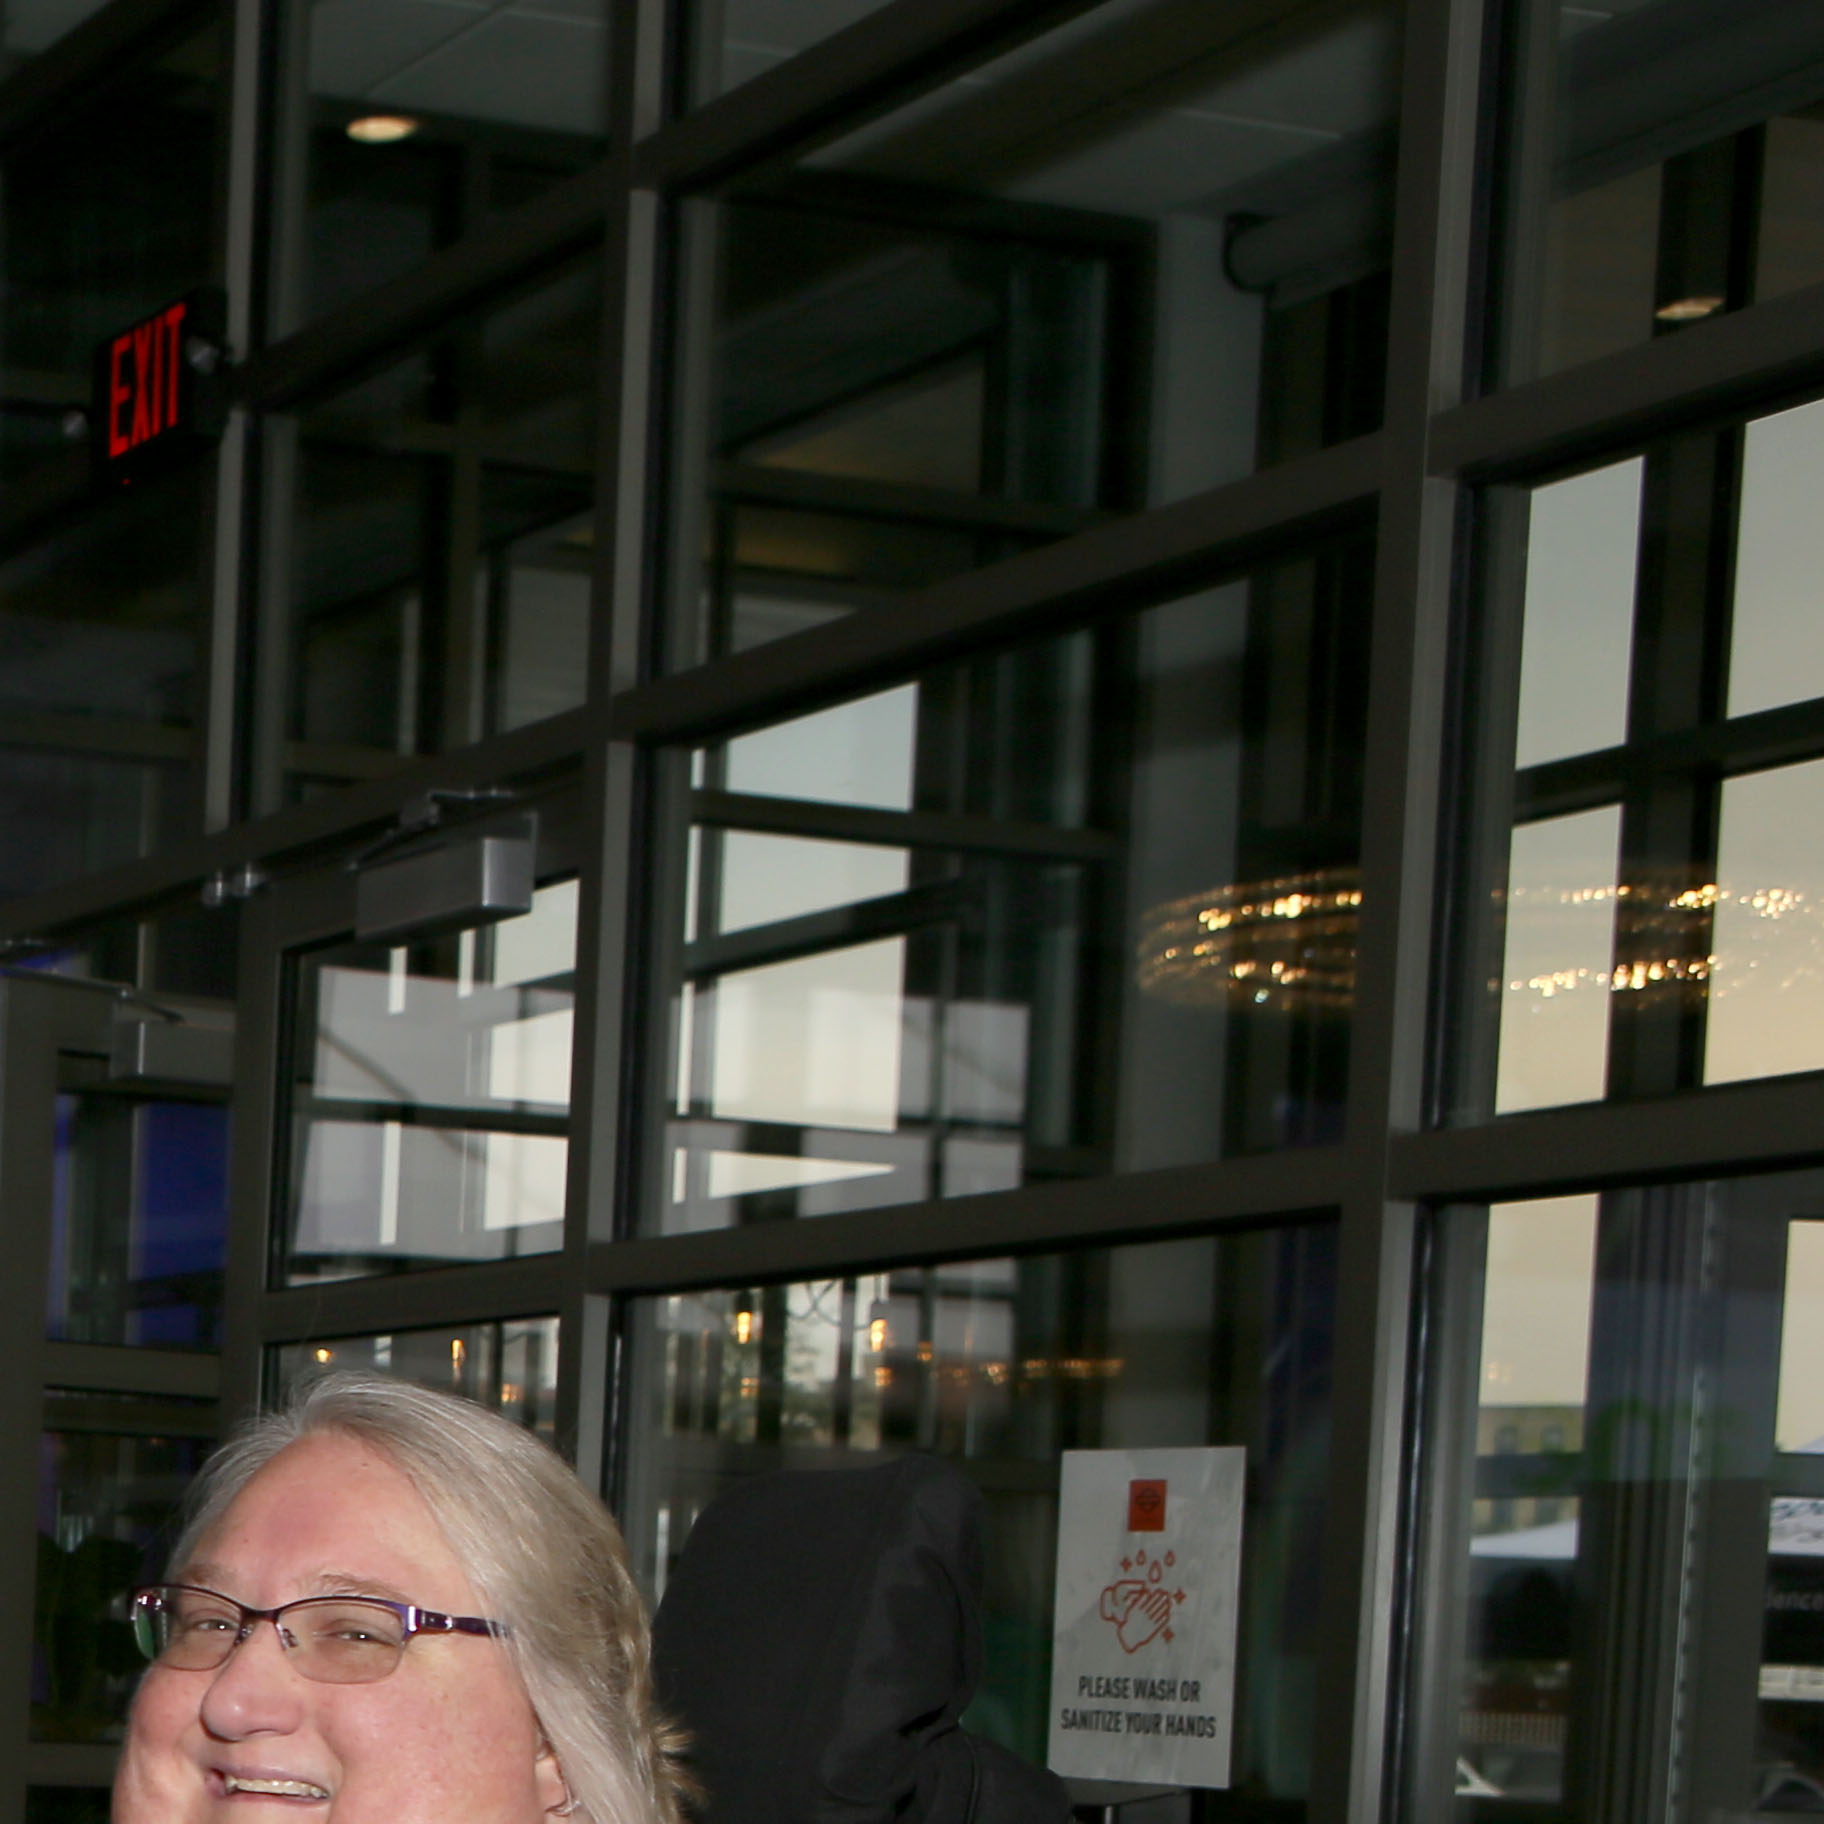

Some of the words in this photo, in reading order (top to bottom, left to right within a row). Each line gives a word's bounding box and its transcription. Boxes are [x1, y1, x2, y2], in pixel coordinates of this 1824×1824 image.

[108, 303, 187, 458] EXIT
[1078, 1675, 1131, 1699] PLEASE
[1133, 1678, 1178, 1700] WASH
[1179, 1680, 1201, 1702] OR
[1060, 1708, 1122, 1733] SANITIZE
[1125, 1711, 1163, 1735] YOUR
[1165, 1713, 1216, 1739] HANDS
